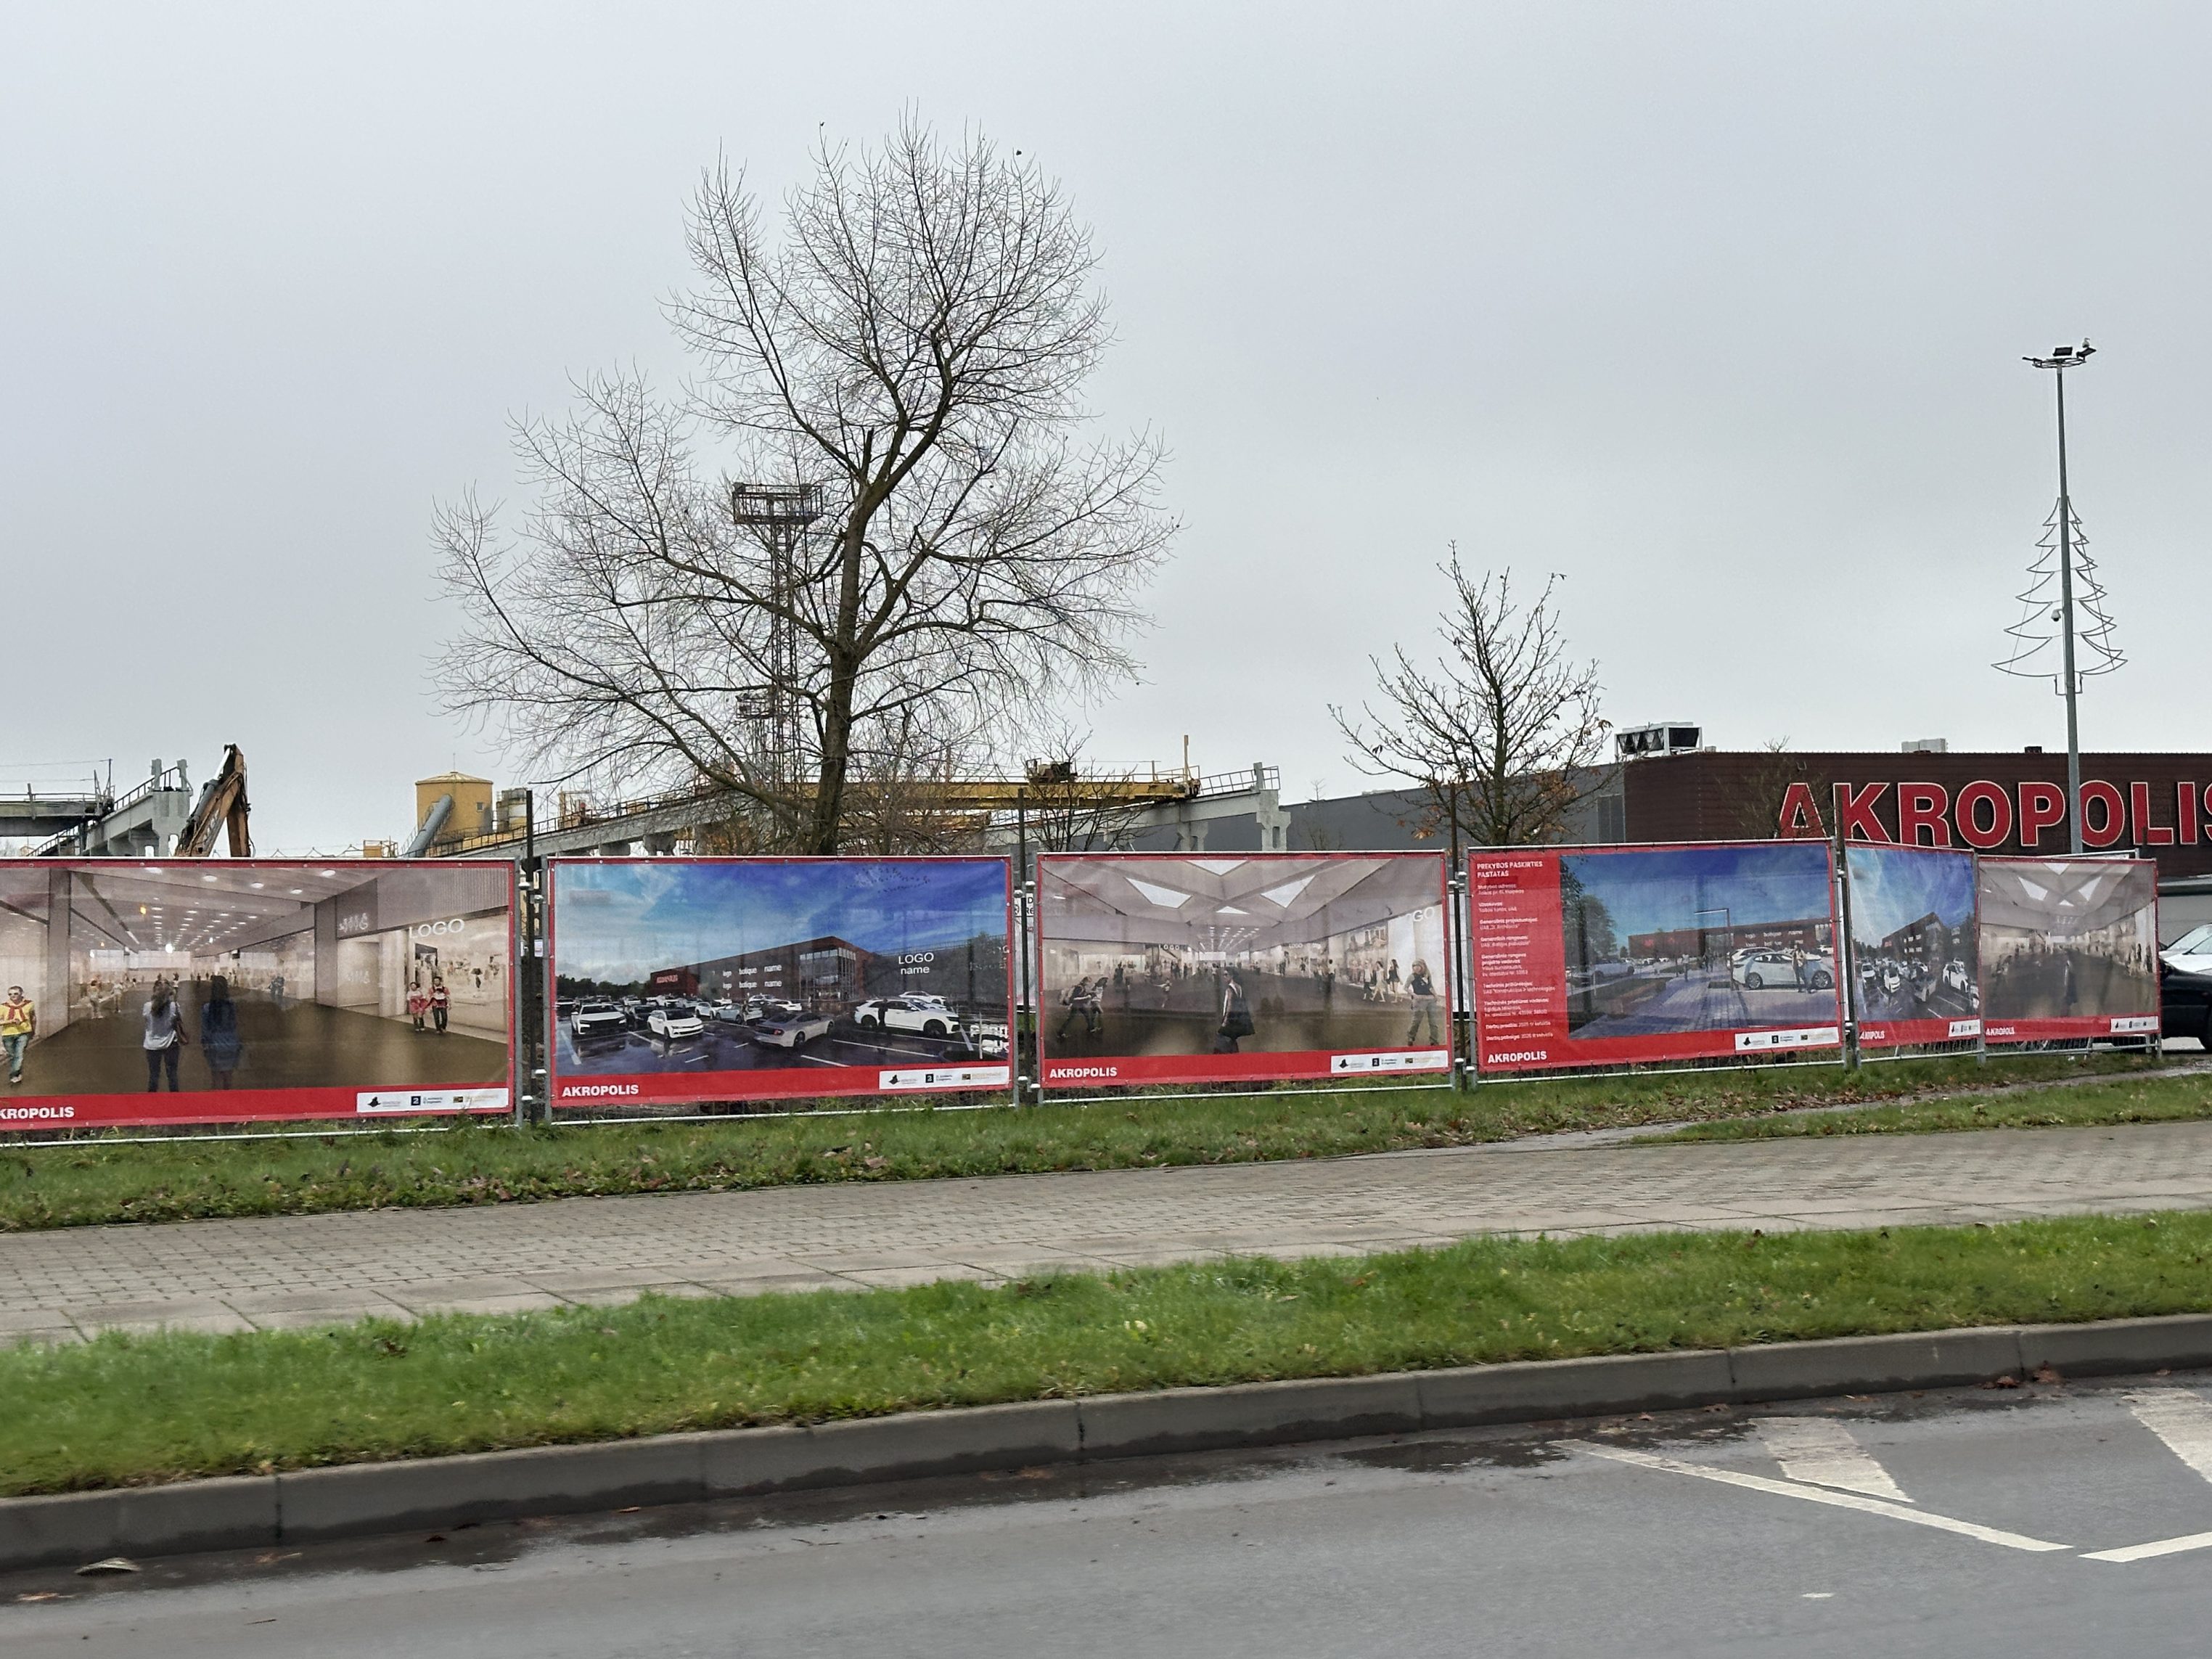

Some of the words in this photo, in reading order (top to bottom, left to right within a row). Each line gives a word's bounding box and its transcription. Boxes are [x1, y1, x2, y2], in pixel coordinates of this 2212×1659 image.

[409, 919, 465, 939] LOGO
[898, 952, 934, 964] LOGO
[900, 966, 930, 975] name
[1488, 1051, 1547, 1063] AKROPOLIS
[1049, 1067, 1118, 1078] AKROPOLIS
[562, 1084, 639, 1097] AKROPOLIS
